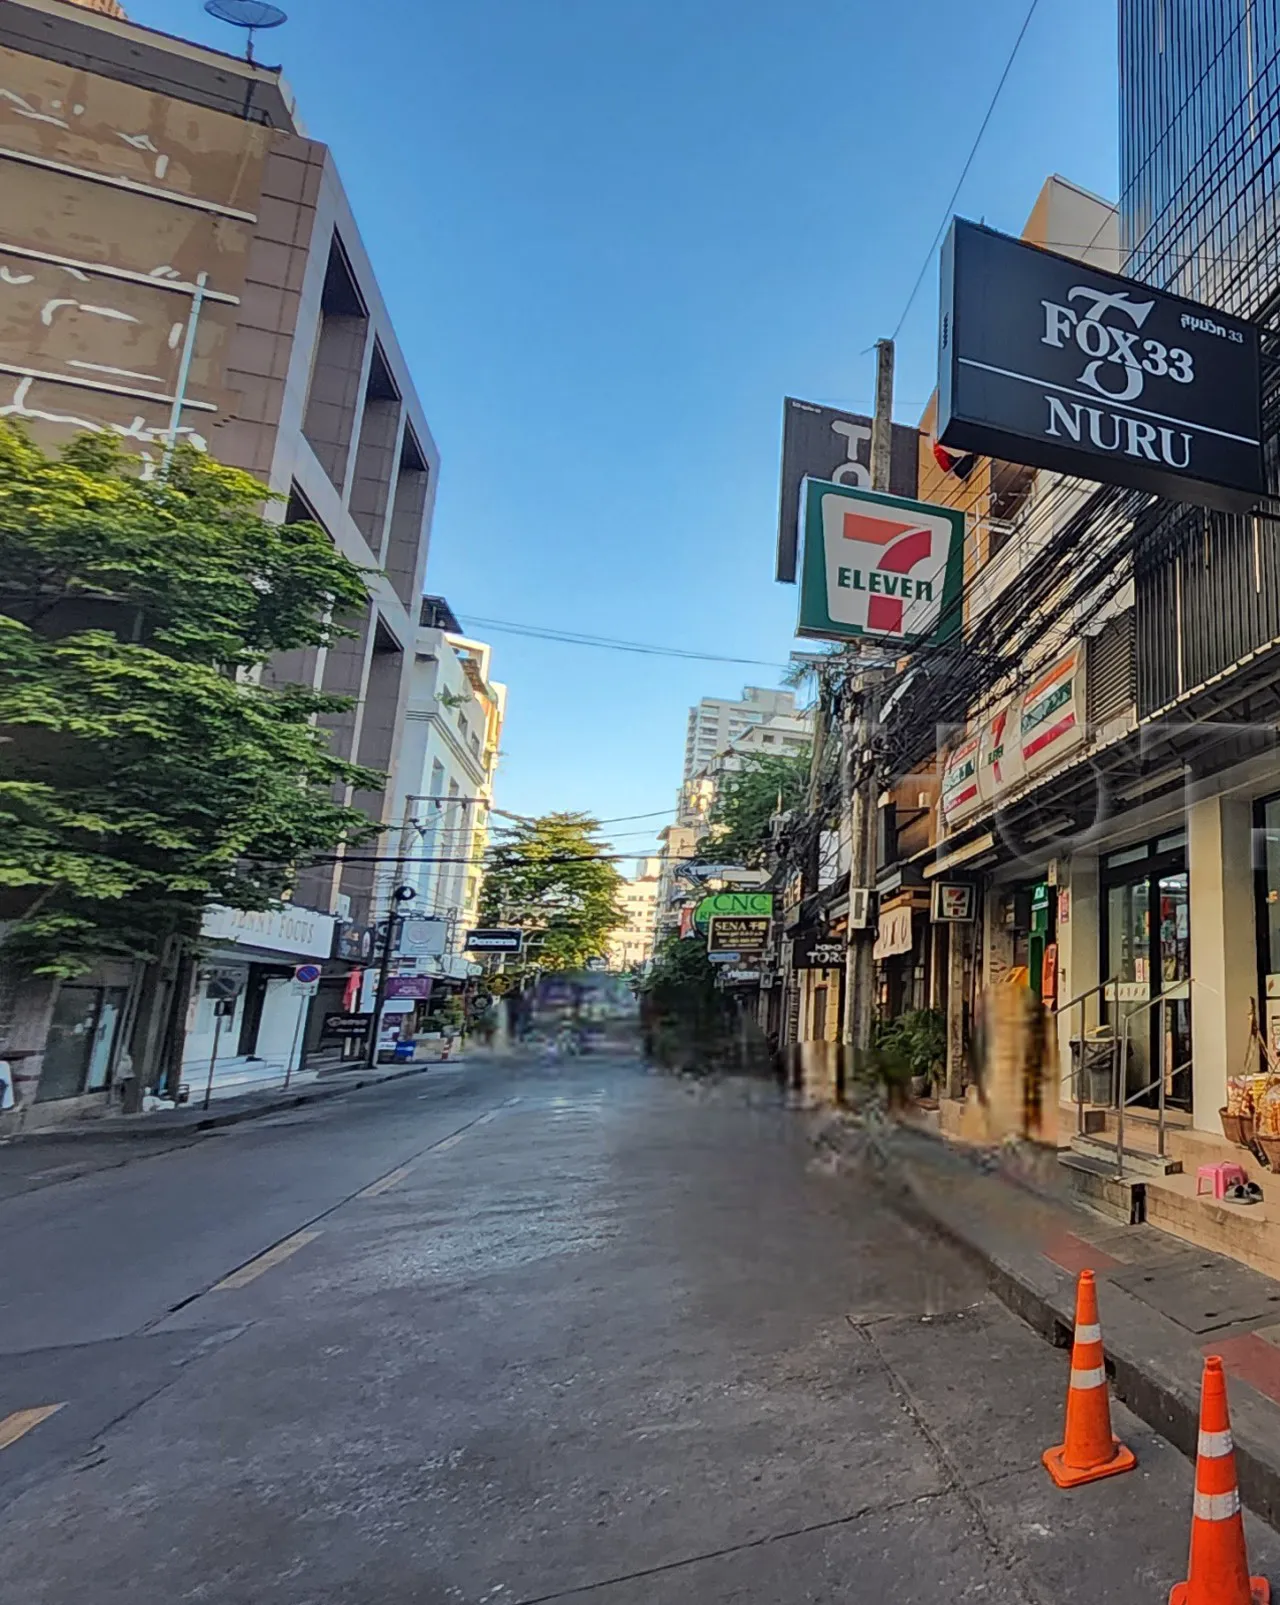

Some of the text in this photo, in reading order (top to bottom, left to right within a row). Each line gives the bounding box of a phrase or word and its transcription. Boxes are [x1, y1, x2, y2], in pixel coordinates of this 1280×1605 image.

[1180, 313, 1244, 344] สุขุมวิท 33
[1044, 394, 1193, 469] NURU
[842, 511, 933, 633] 7
[713, 894, 768, 911] CNC
[714, 921, 747, 931] SENA
